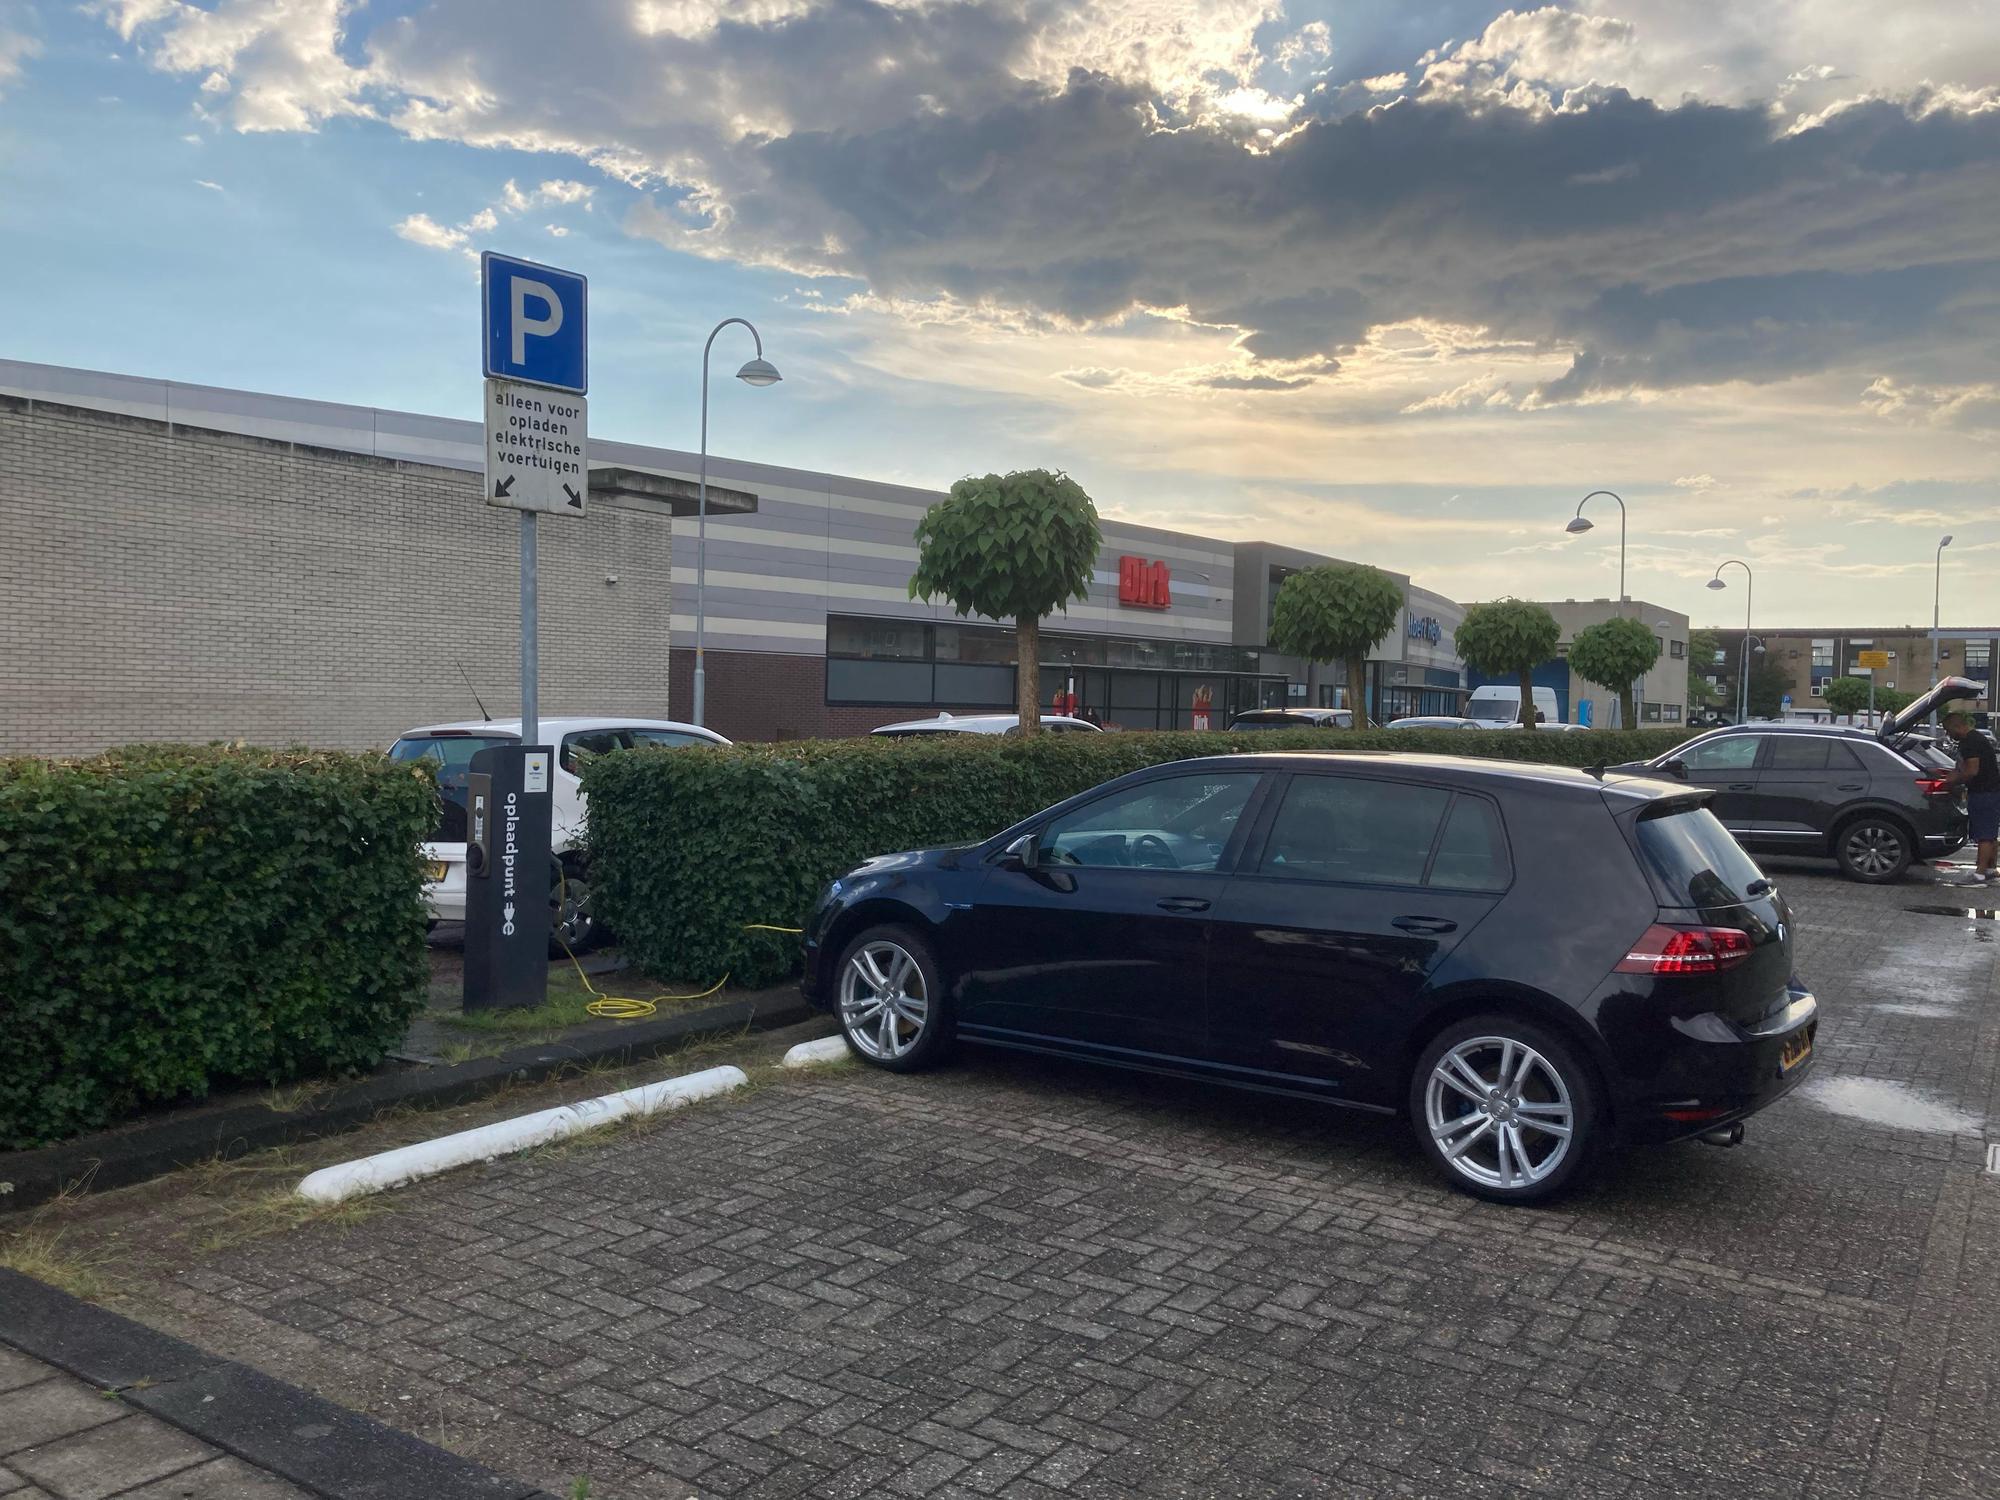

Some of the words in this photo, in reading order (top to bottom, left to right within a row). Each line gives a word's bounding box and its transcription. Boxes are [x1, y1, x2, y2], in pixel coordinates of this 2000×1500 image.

[511, 275, 564, 366] P
[495, 393, 542, 412] alleen
[548, 403, 580, 419] voor
[509, 415, 568, 435] opladen
[495, 430, 581, 455] elektrische
[497, 451, 579, 475] voertuigen
[1120, 555, 1171, 608] Dirk
[502, 793, 520, 897] oplaadpunt
